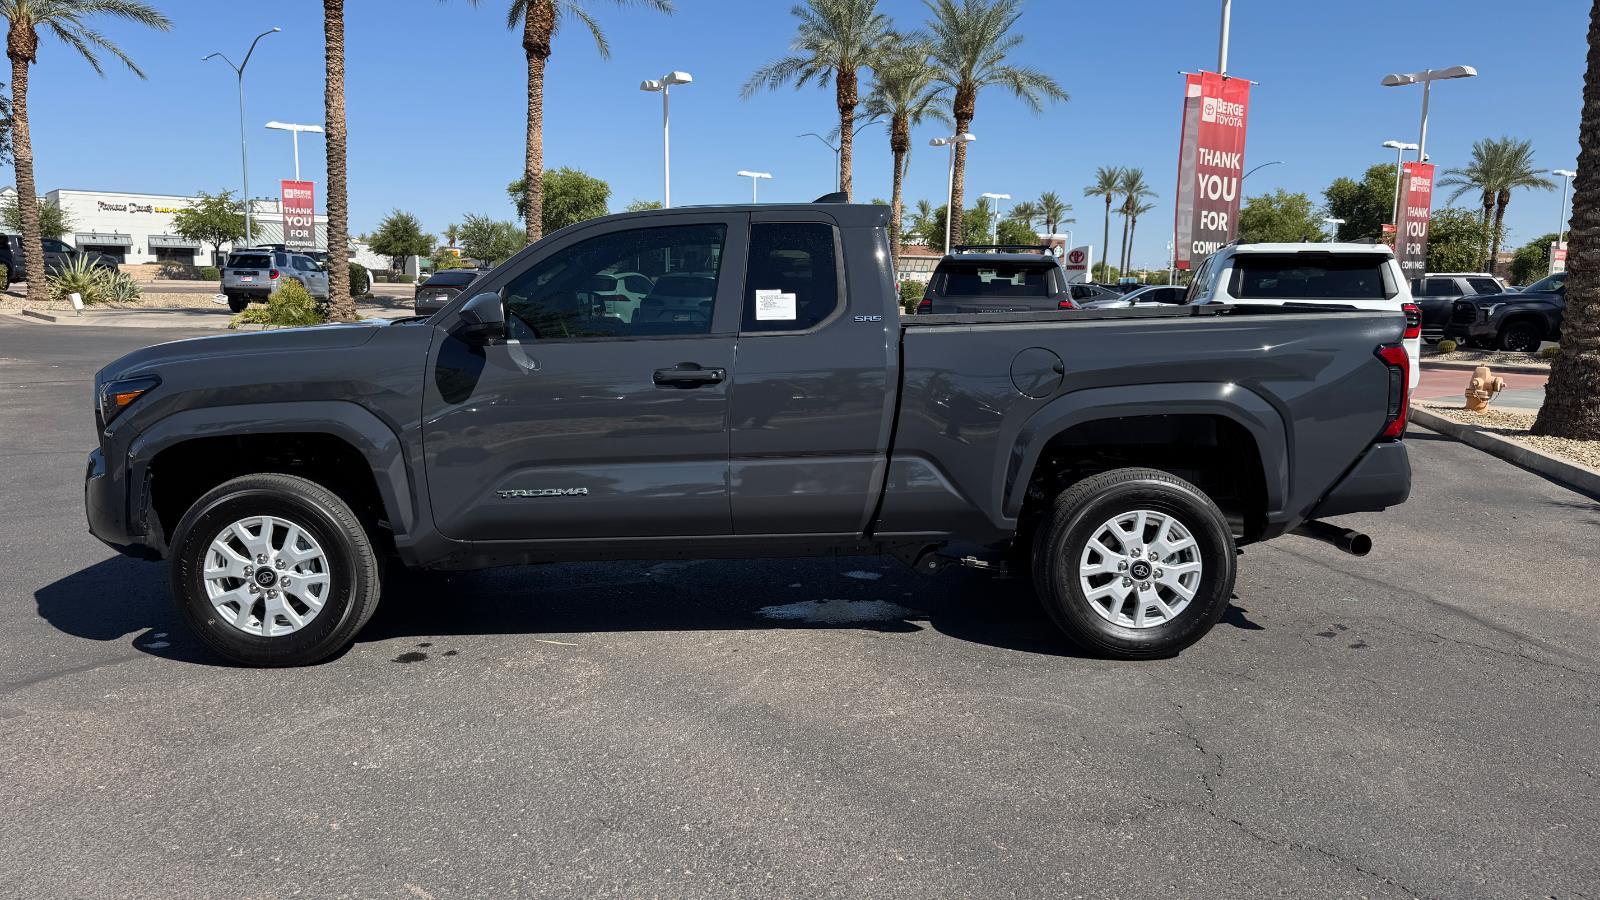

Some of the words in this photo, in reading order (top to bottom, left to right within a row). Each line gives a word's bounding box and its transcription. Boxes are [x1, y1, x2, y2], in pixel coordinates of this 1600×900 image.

[1216, 98, 1244, 117] BERGE
[1216, 114, 1243, 128] TOYOTA
[1199, 147, 1241, 170] THANK
[1198, 172, 1237, 202] YOU
[1407, 206, 1428, 218] THANK
[286, 216, 311, 226] YOU
[1200, 210, 1228, 232] FOR
[290, 229, 309, 238] FOR
[1406, 221, 1426, 237] YOU
[1406, 243, 1421, 255] FOR
[1402, 261, 1424, 269] COMING!
[497, 487, 589, 498] TACOMA
